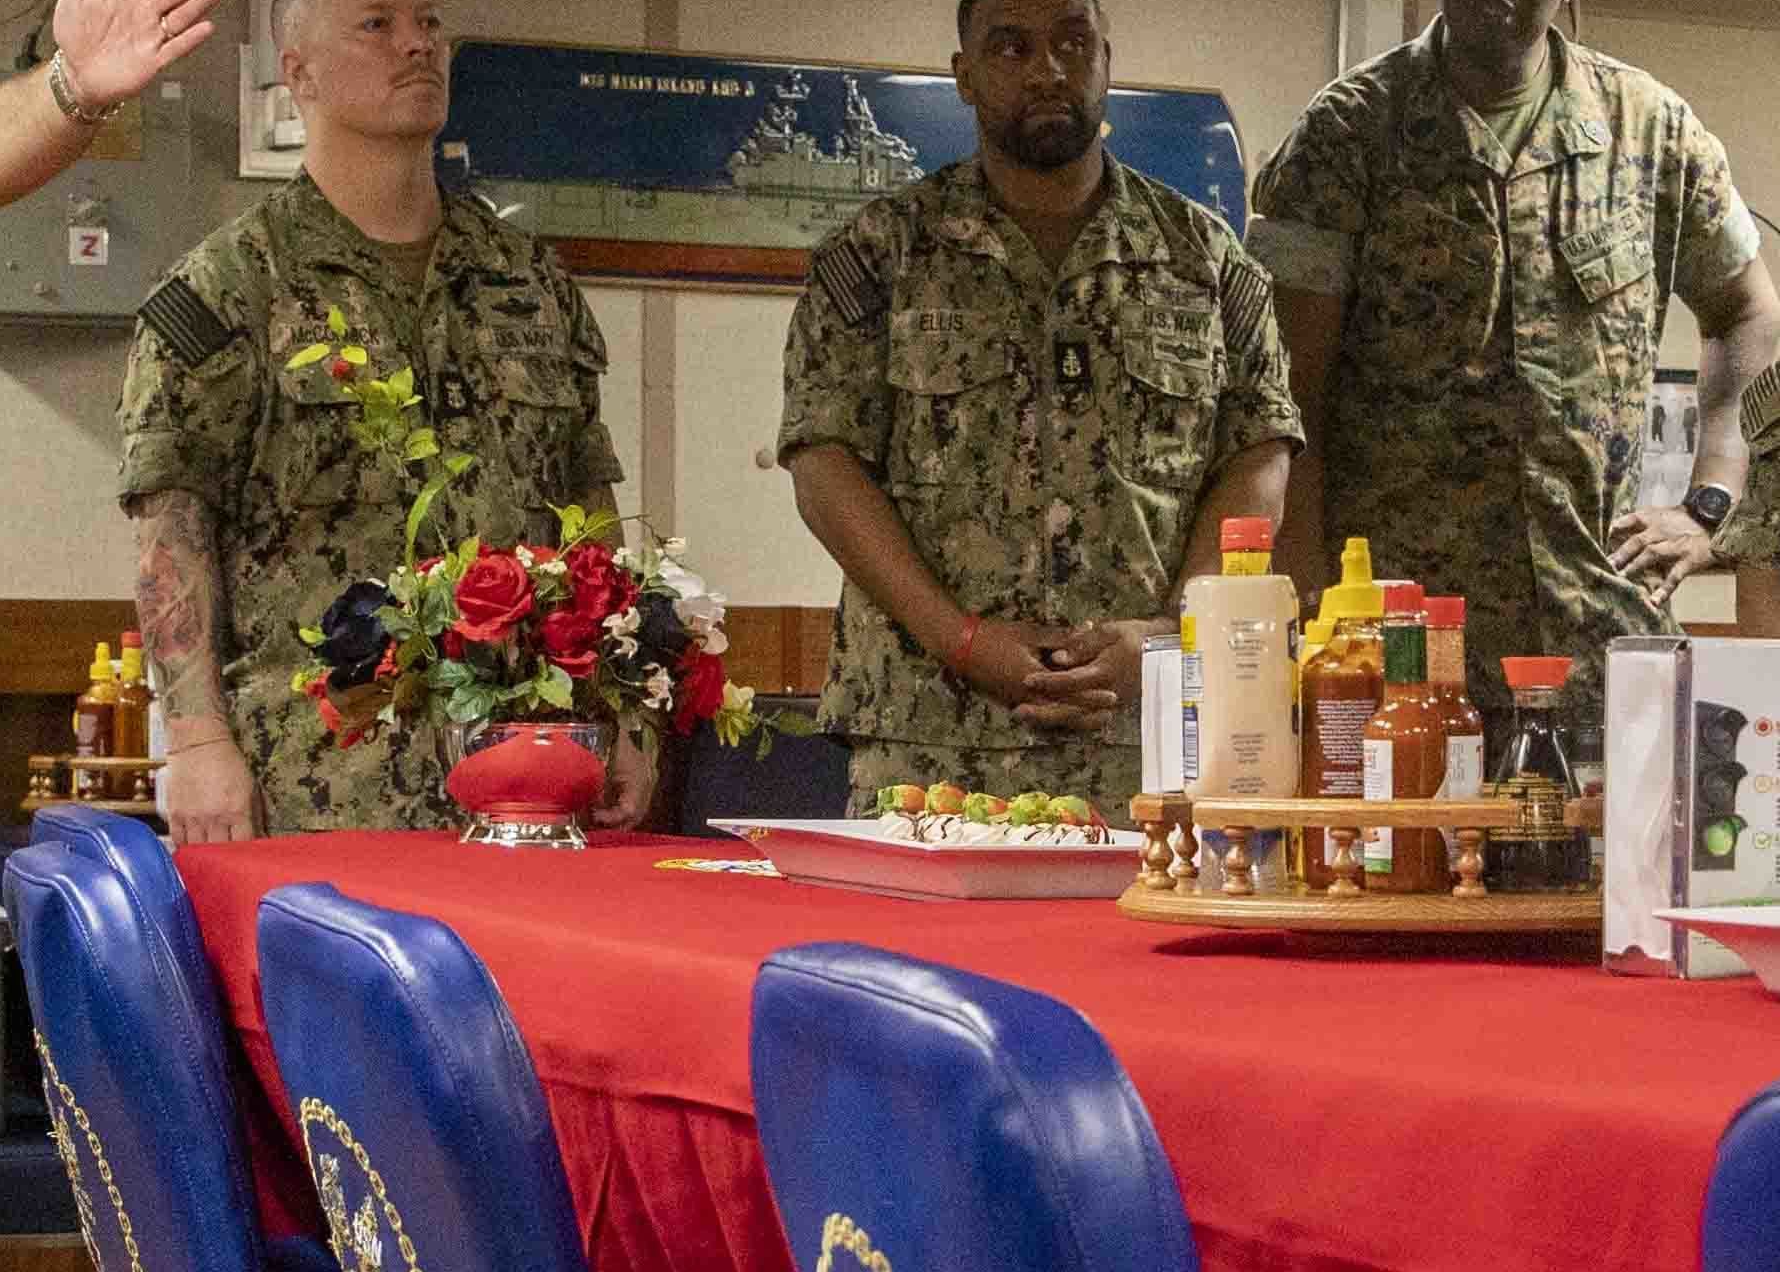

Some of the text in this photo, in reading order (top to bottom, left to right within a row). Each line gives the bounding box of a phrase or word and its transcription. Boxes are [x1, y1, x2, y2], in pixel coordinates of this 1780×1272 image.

[919, 313, 963, 331] ELLIS
[1175, 312, 1212, 335] NAVY
[291, 325, 380, 346] McCOMICK
